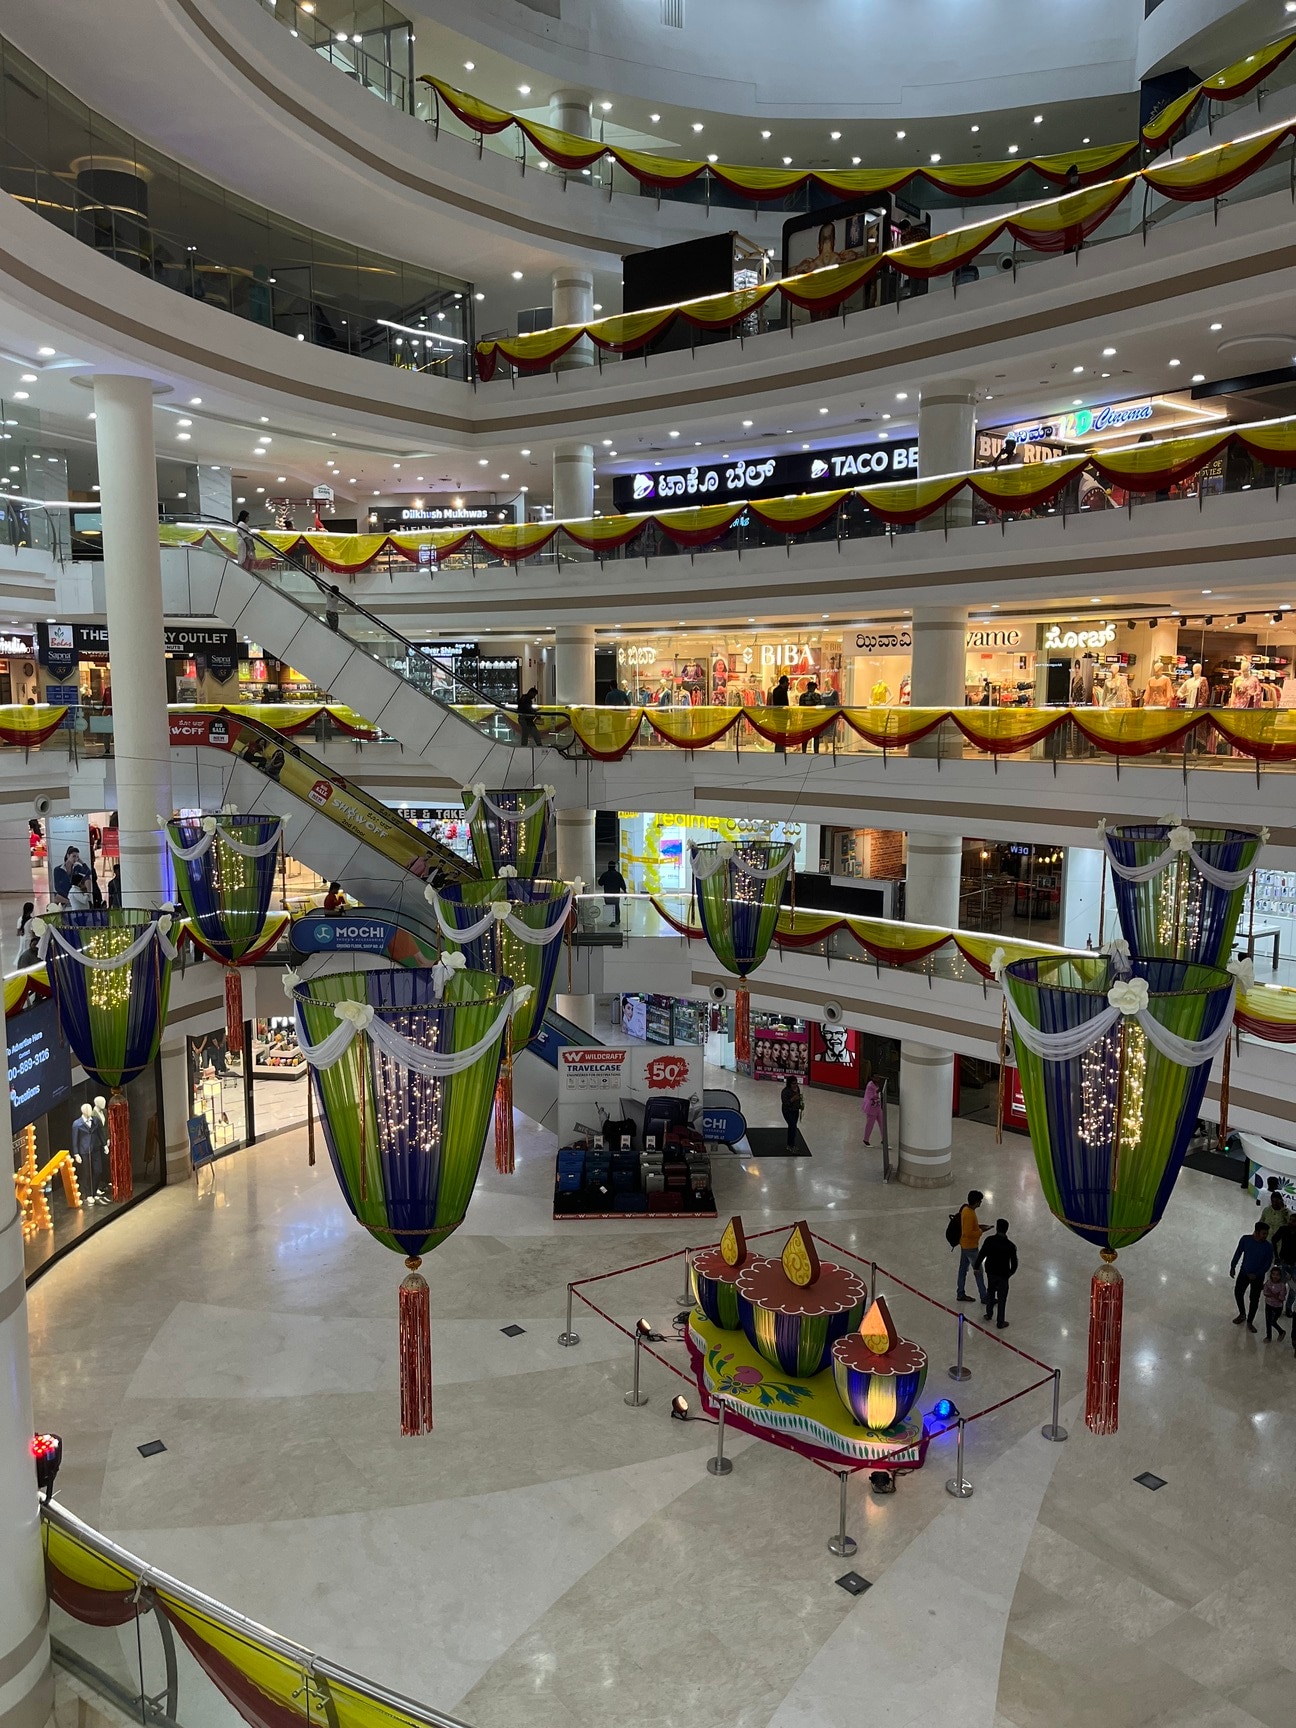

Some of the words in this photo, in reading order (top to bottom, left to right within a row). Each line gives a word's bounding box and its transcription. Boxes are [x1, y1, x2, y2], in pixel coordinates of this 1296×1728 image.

[1094, 405, 1153, 431] Cinema
[831, 451, 888, 477] TACO
[725, 459, 776, 489] ಬೆಲ್
[402, 510, 442, 519] Dilkhush
[444, 509, 488, 518] Mukhwas
[51, 638, 72, 647] Bolas
[80, 629, 108, 640] THE
[179, 633, 228, 643] OUTLET
[967, 630, 1019, 647] vame
[48, 651, 71, 661] Sapna
[211, 655, 231, 664] Sapna
[761, 645, 815, 665] BIBA
[332, 799, 389, 839] SHOWOFF
[398, 809, 417, 819] SEE
[422, 809, 431, 819] &
[436, 809, 465, 819] TAKE
[341, 819, 352, 828] 2nd
[351, 823, 366, 837] Floor
[336, 927, 384, 937] MOCHI
[11, 1037, 32, 1054] Advertise
[32, 1031, 43, 1042] Here
[13, 1084, 41, 1108] Creations
[703, 1118, 726, 1129] CHI
